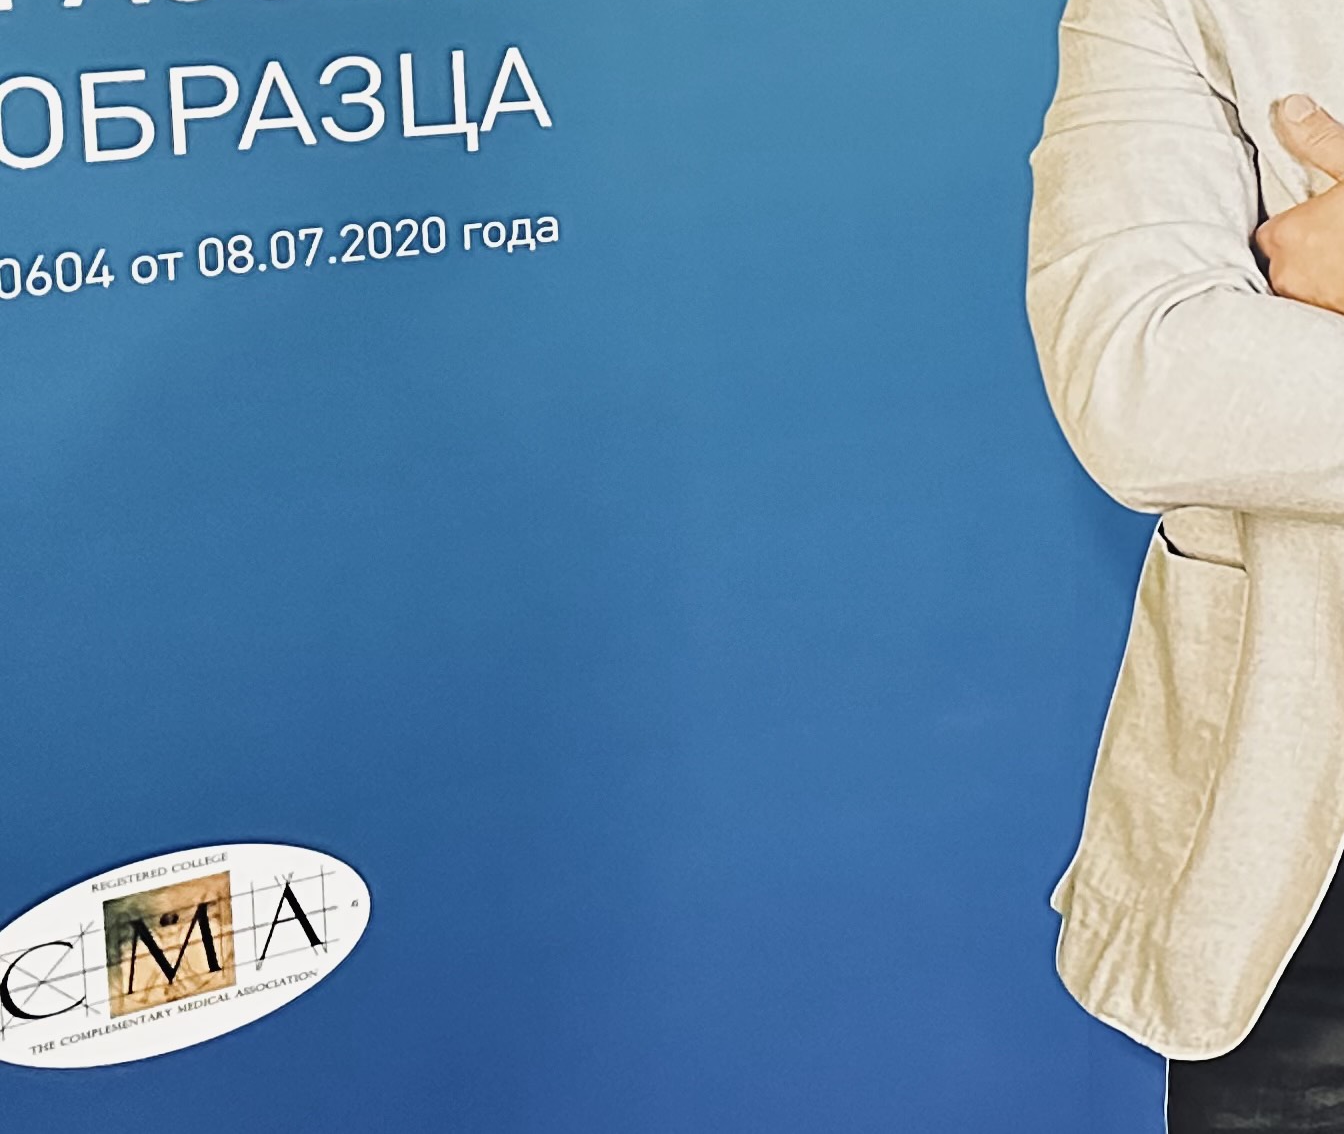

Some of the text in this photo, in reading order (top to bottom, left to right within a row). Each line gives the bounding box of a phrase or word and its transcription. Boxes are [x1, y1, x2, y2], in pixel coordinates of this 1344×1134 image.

[0, 46, 553, 170] ОБРАЗЦА
[0, 215, 561, 300] 0604 от 08.07.2020 года
[91, 852, 228, 893] REGISTERED COLLEGE
[29, 969, 319, 1056] THE COMPLEMENTARY MEDICAL ASSOCIATION
